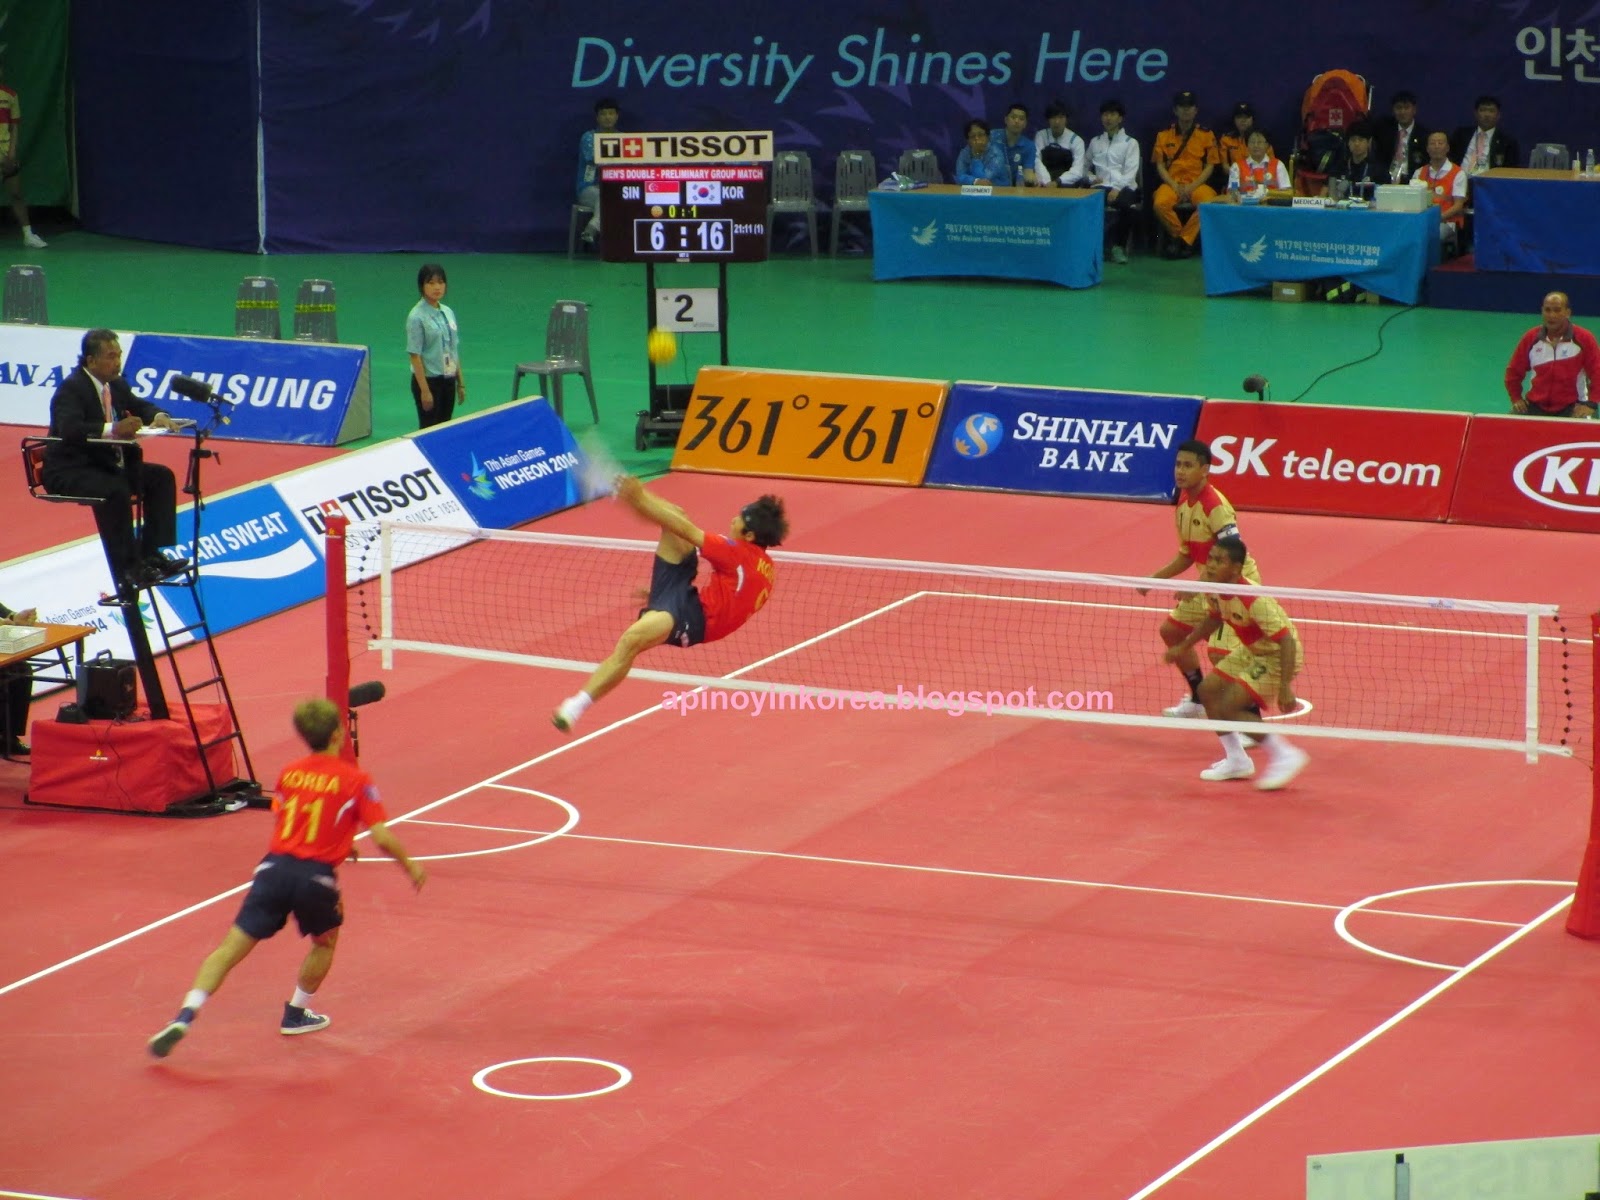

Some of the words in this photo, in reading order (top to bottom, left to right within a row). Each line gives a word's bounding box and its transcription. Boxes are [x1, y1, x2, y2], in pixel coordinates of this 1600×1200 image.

[571, 36, 815, 104] Diversity
[831, 27, 1012, 88] Shines
[1034, 30, 1168, 83] Here
[647, 134, 768, 158] TISSOT
[602, 169, 626, 179] MEN'S
[626, 169, 655, 179] DOUBLE
[660, 169, 709, 180] PRELIMINARY
[710, 169, 736, 180] GROUP
[737, 169, 763, 179] MATCH
[622, 186, 640, 199] SIN
[722, 186, 744, 199] KOR
[1294, 198, 1323, 206] MEDICAL
[668, 205, 676, 218] 0
[691, 205, 697, 218] 1
[650, 222, 664, 250] 6
[697, 222, 724, 250] 16
[734, 224, 752, 233] 21:11
[753, 224, 763, 234] (1)
[674, 294, 694, 322] 2
[131, 367, 337, 411] SAMSUNG
[1013, 412, 1178, 449] SHINHAN
[483, 459, 502, 472] 17th
[498, 453, 521, 468] Asian
[517, 446, 546, 463] Games
[494, 460, 552, 490] INCHEON
[548, 451, 579, 472] 2014
[1039, 448, 1133, 473] BANK
[1209, 435, 1278, 476] SK
[1282, 448, 1441, 487] telecom
[337, 467, 441, 521] TISSOT
[220, 511, 288, 551] SWEAT
[67, 604, 97, 619] Games
[282, 769, 340, 794] KOREA
[280, 794, 324, 844] 11
